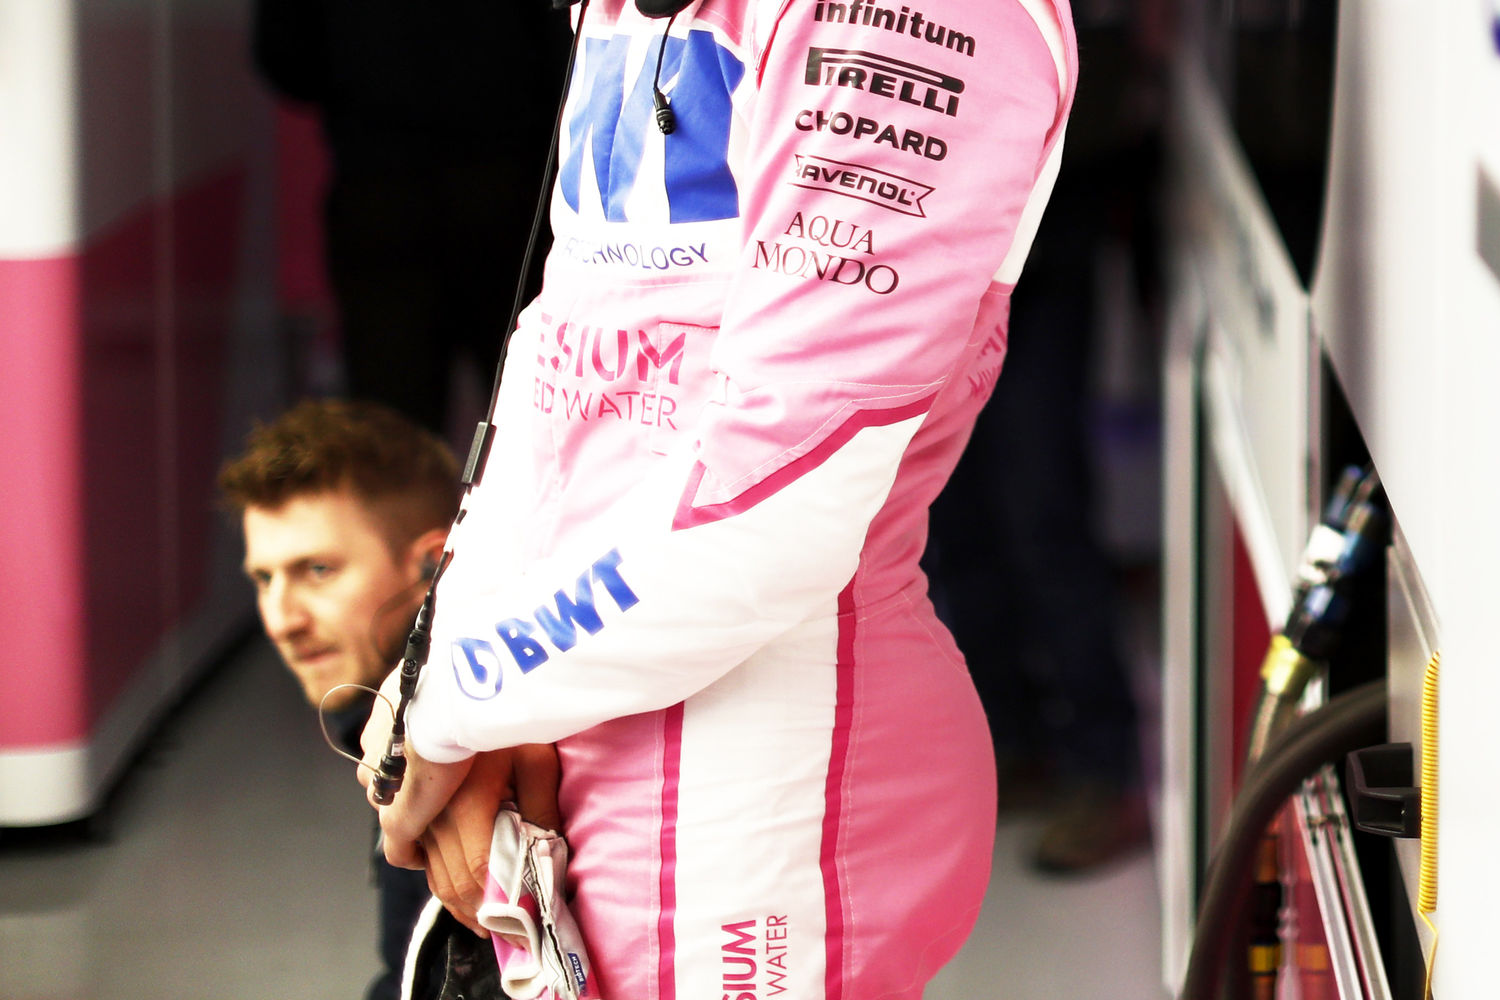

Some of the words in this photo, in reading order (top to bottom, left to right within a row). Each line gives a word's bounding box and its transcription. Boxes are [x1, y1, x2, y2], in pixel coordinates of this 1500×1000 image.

[804, 46, 966, 118] PIRELLI
[794, 109, 948, 162] CHOPARD
[783, 210, 876, 256] AQUA
[751, 239, 900, 295] MONDO
[562, 389, 678, 431] WATER
[494, 546, 640, 675] BWT
[765, 914, 788, 997] WATER
